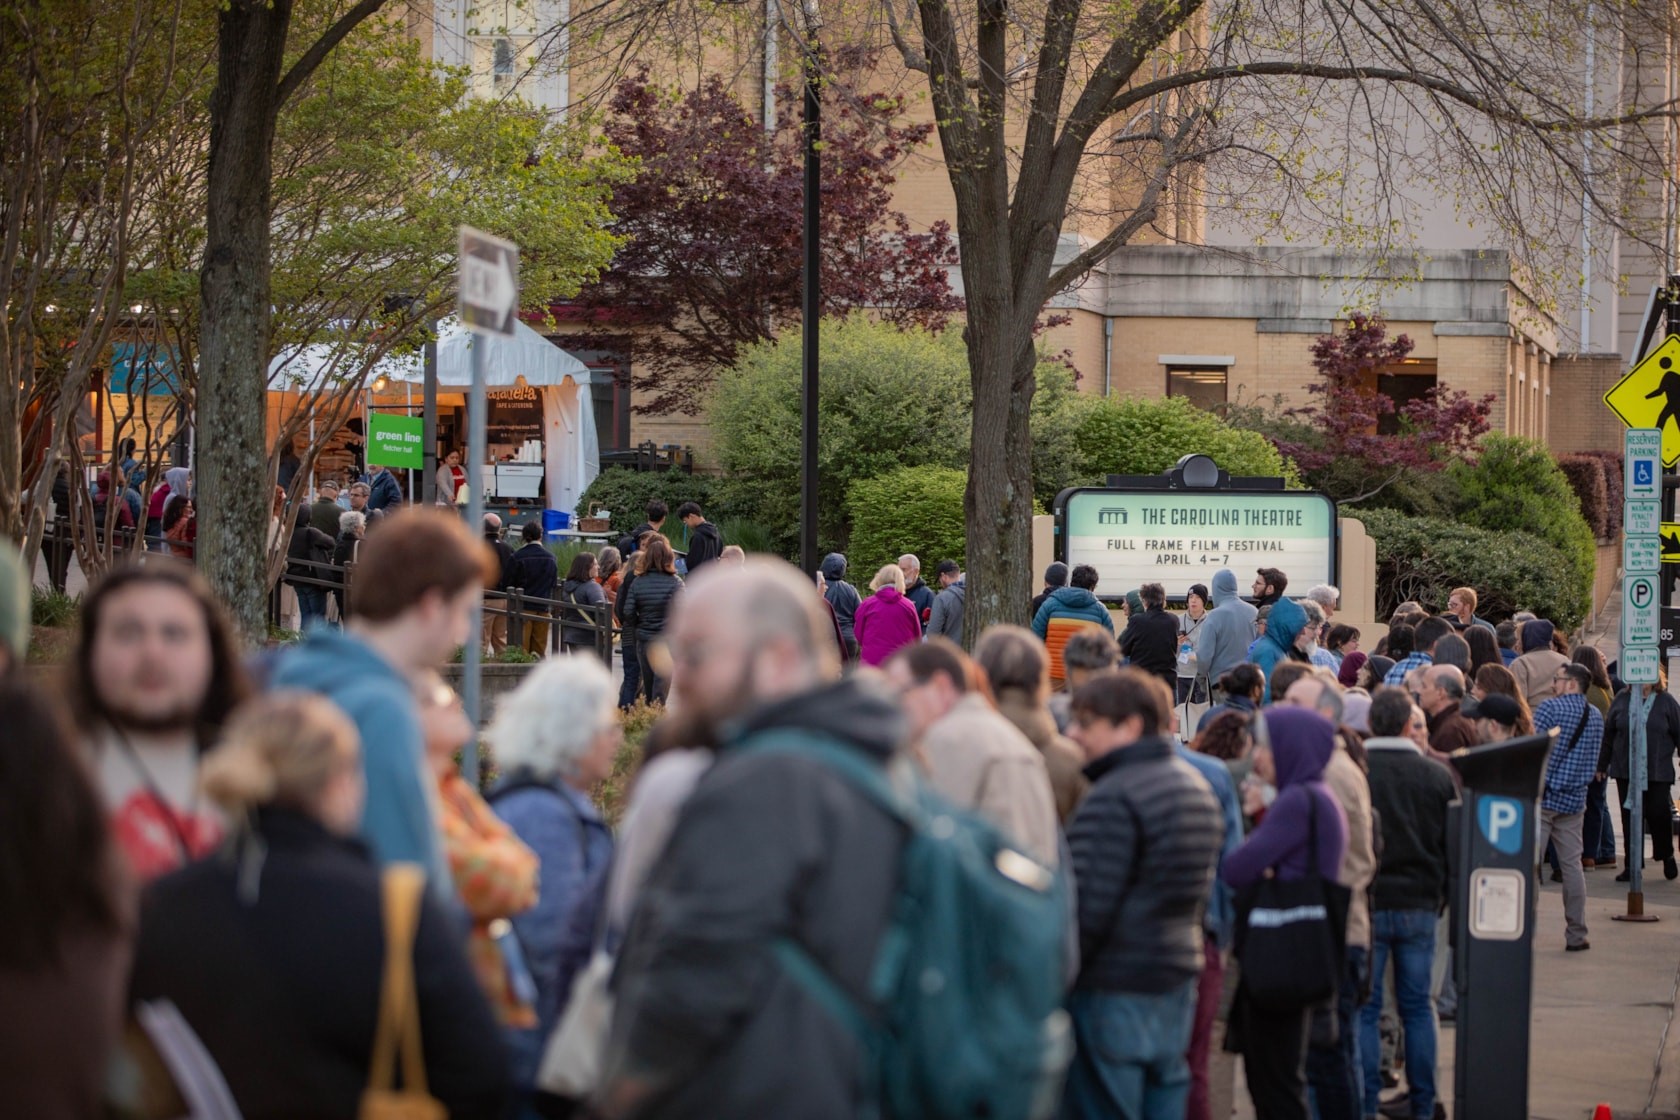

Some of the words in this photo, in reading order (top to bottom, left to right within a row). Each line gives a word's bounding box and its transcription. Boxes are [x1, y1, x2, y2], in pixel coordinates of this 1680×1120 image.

[376, 431, 402, 441] green
[404, 431, 421, 443] line
[1628, 435, 1659, 445] RESERVED
[383, 444, 402, 452] fletcher
[1630, 447, 1657, 457] PARKING
[1141, 508, 1166, 525] THE
[1171, 508, 1240, 526] CAROLINA
[1245, 509, 1302, 526] THEATRE
[1631, 513, 1653, 521] PENALTY
[1107, 539, 1136, 550] FULL
[1145, 539, 1183, 551] FRAME
[1191, 540, 1219, 551] FILM
[1228, 540, 1284, 551] FESTIVAL
[1156, 554, 1191, 565] APRIL
[1636, 584, 1648, 603] P
[1630, 626, 1653, 634] PARKING
[1647, 654, 1657, 662] 7PM
[1631, 667, 1652, 675] MON-FRI
[1488, 801, 1518, 844] P
